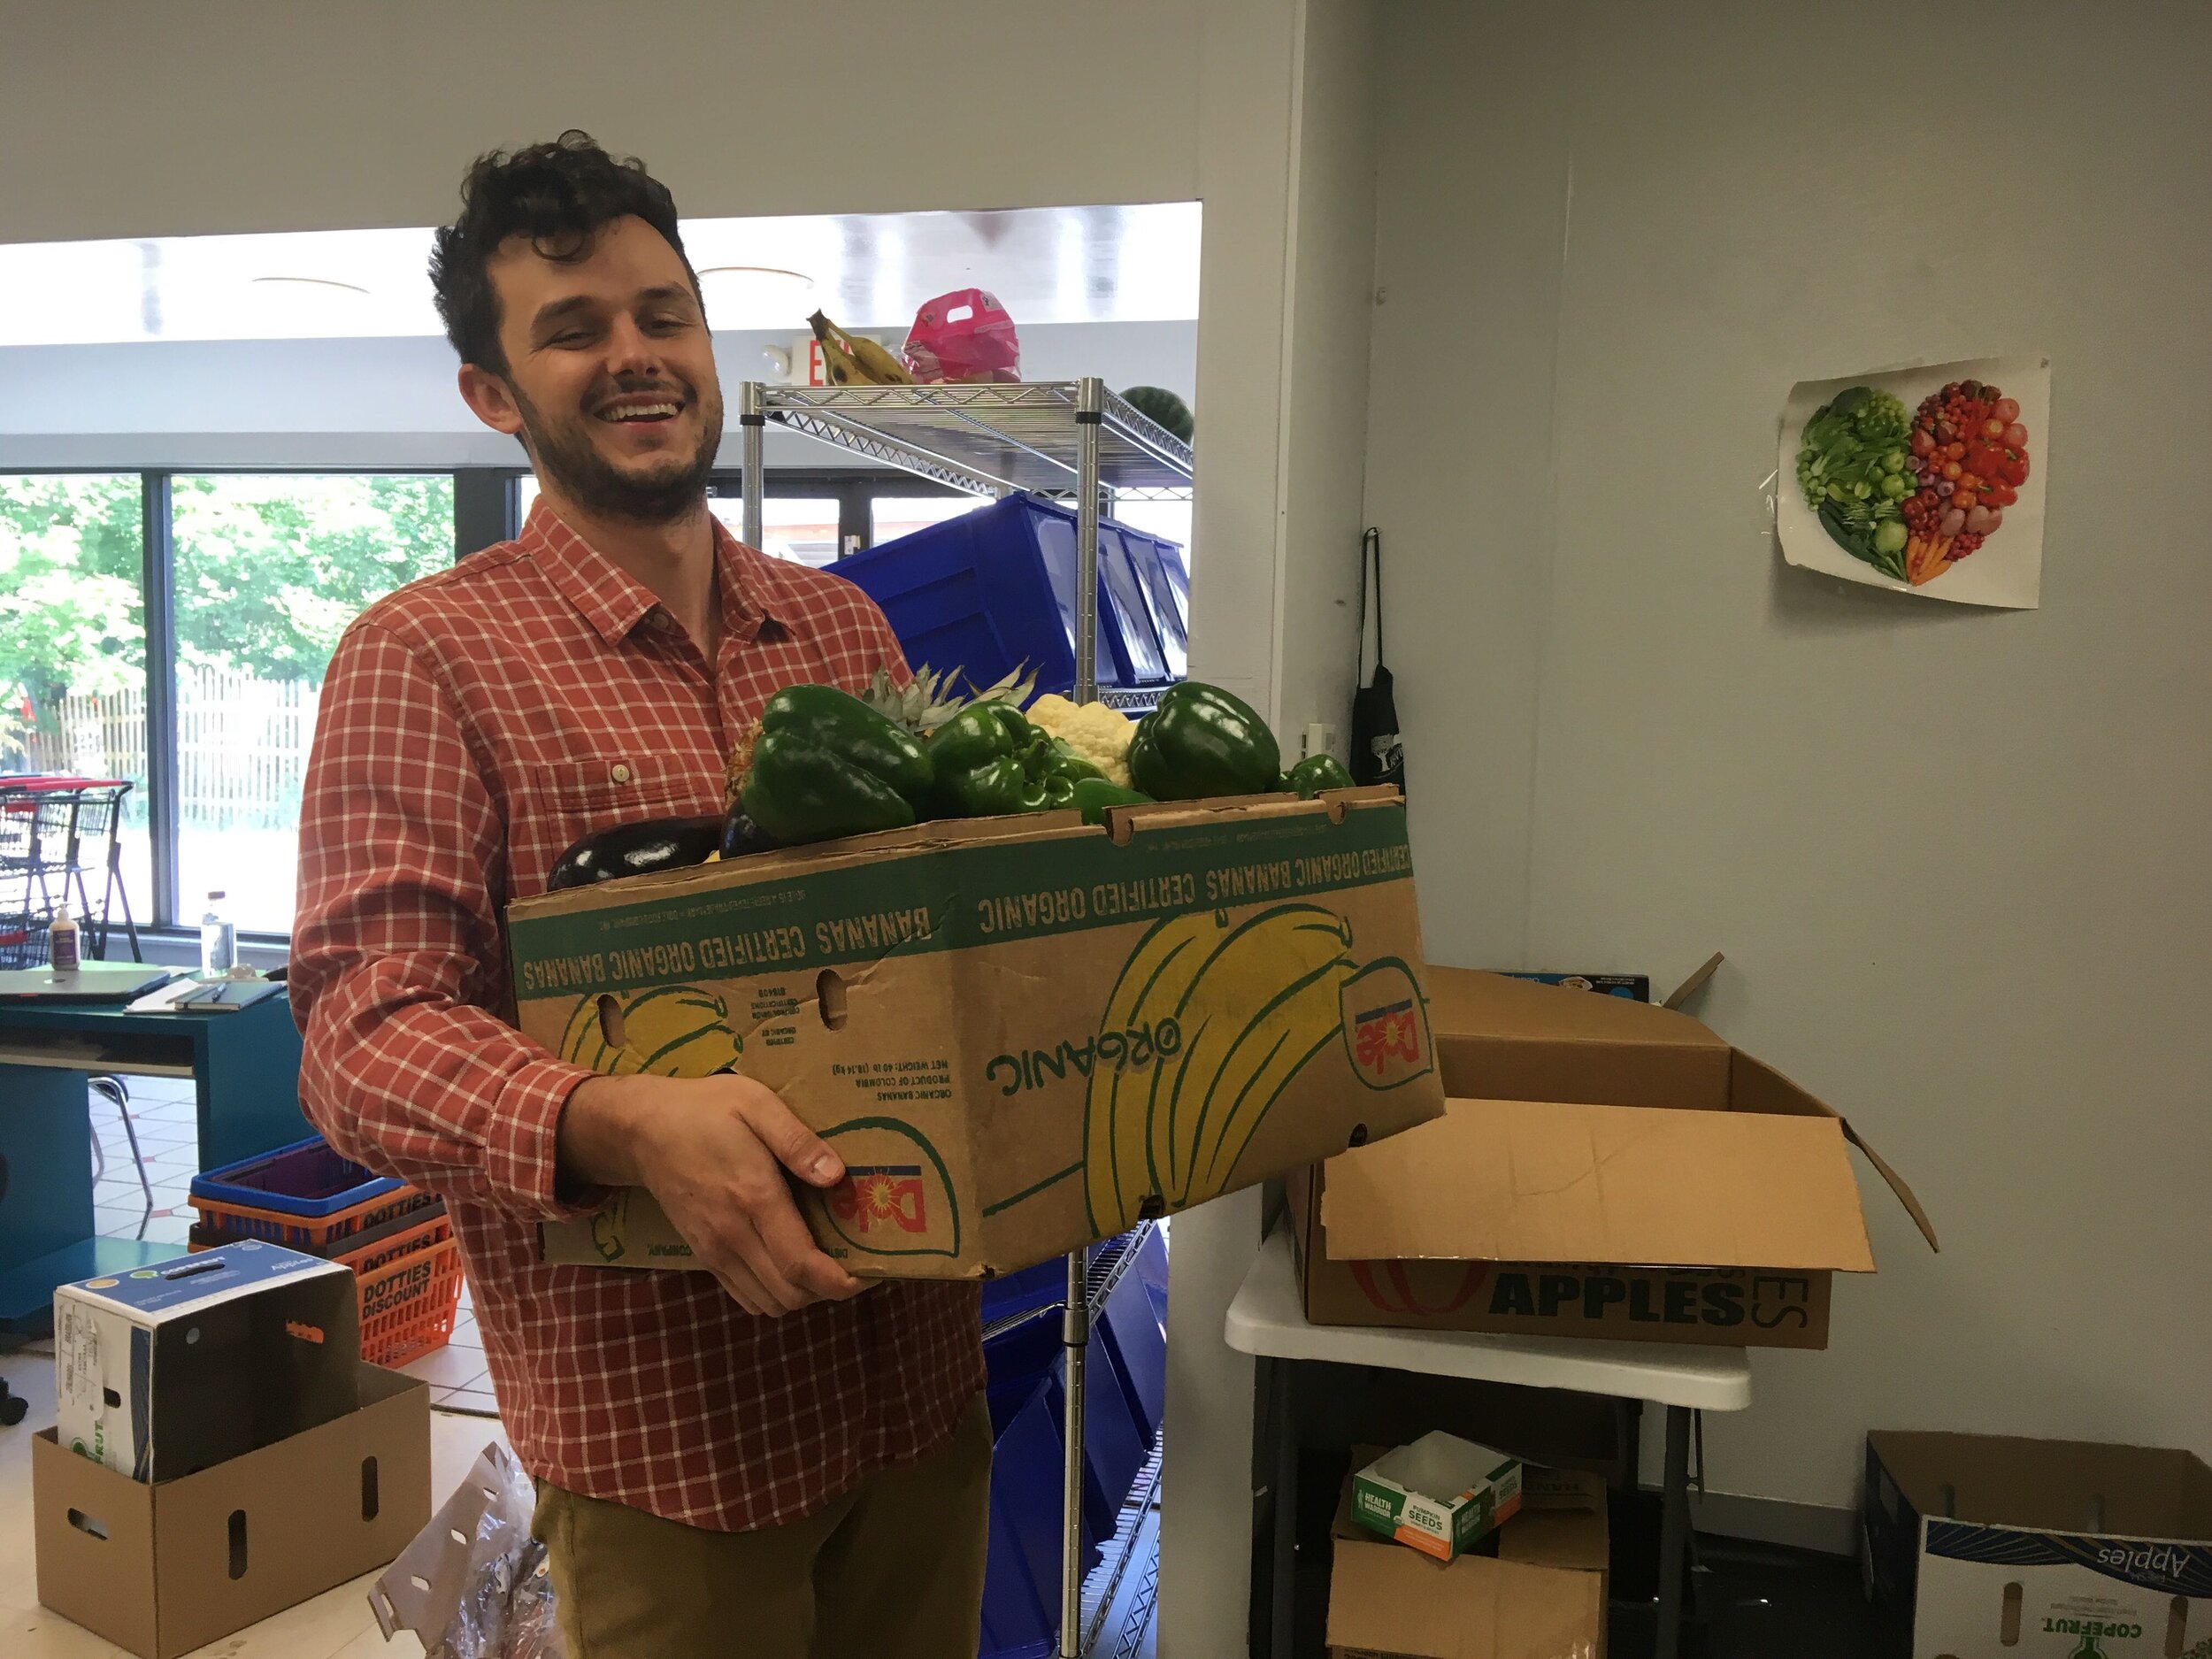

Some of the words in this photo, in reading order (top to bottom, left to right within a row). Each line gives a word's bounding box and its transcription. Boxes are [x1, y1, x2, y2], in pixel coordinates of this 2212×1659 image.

[1295, 849, 1358, 884] ORGANIC
[1206, 859, 1292, 901] BANANAS
[1093, 872, 1196, 915] CERTIFIED
[979, 891, 1087, 933] ORGANIC
[816, 905, 931, 955] BANANAS
[700, 926, 807, 967] CERTIFIED
[609, 940, 695, 977] ORGANIC
[524, 954, 604, 989] BANANAS
[895, 1061, 928, 1071] WEIGHT:
[931, 1060, 948, 1070] NET
[987, 1016, 1182, 1096] ORGANIC
[832, 1064, 845, 1075] kg)
[847, 1063, 869, 1075] (18.14
[873, 1064, 881, 1072] lb
[883, 1064, 893, 1072] 40
[856, 1078, 895, 1087] COLOMBIA
[898, 1077, 909, 1086] OF
[910, 1075, 950, 1085] PRODUCT
[877, 1091, 913, 1102] BANANAS
[915, 1089, 951, 1100] ORGANIC
[364, 1261, 432, 1304] DOTTIES
[363, 1279, 431, 1320] DISCOUNT
[1488, 1273, 1746, 1325] APPLES
[1363, 1492, 1393, 1510] HEALTH
[1363, 1502, 1392, 1519] WARRIOR
[1408, 1509, 1443, 1532] SEEDS
[1412, 1504, 1441, 1523] PUMPKIN
[2097, 1544, 2190, 1578] Apples
[2042, 1617, 2142, 1640] COPEFRUT
